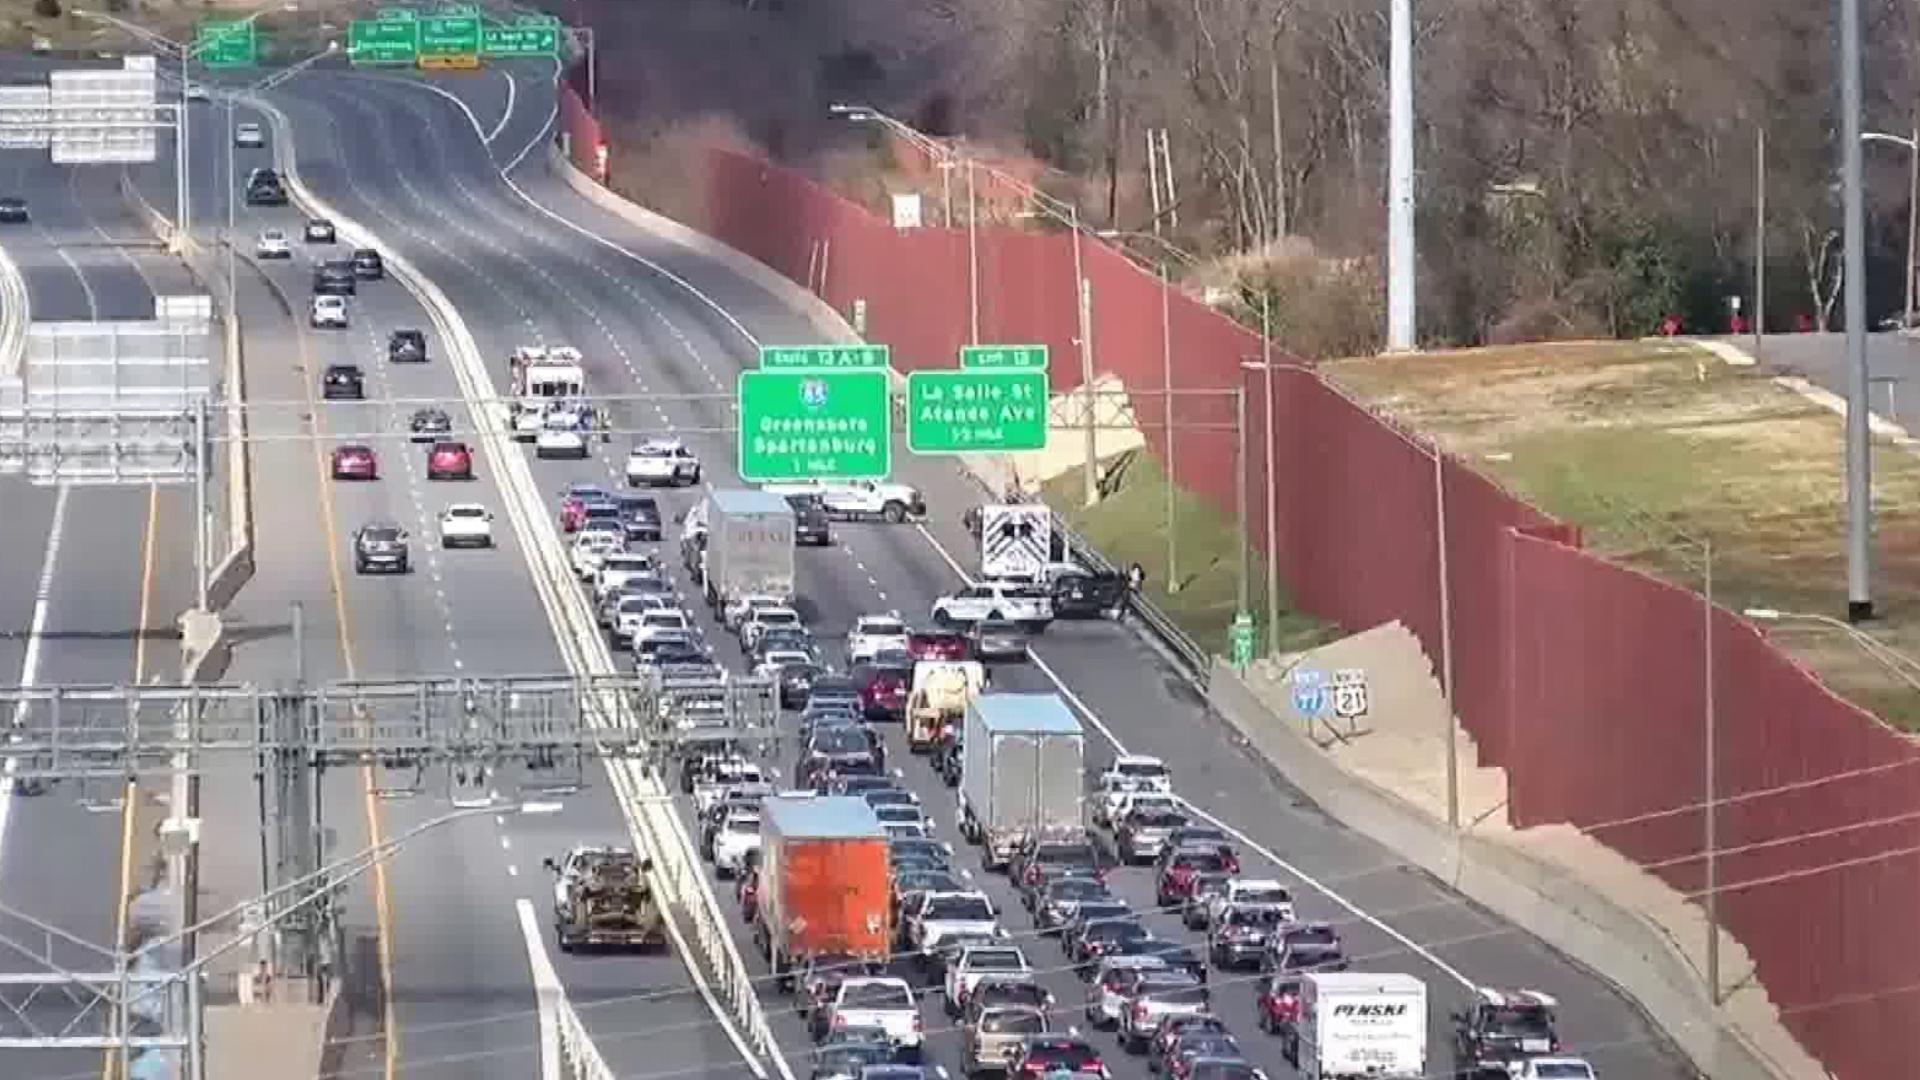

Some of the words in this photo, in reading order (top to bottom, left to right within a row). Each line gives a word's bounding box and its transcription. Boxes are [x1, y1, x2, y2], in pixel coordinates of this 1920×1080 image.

[921, 383, 943, 400] La
[952, 383, 1003, 400] Salle
[1011, 383, 1033, 400] St
[1001, 404, 1035, 422] Ave
[760, 416, 868, 433] Greensboro
[754, 436, 876, 456] Spartanburg
[1342, 692, 1361, 711] 21
[1333, 1004, 1407, 1016] PENSKE
